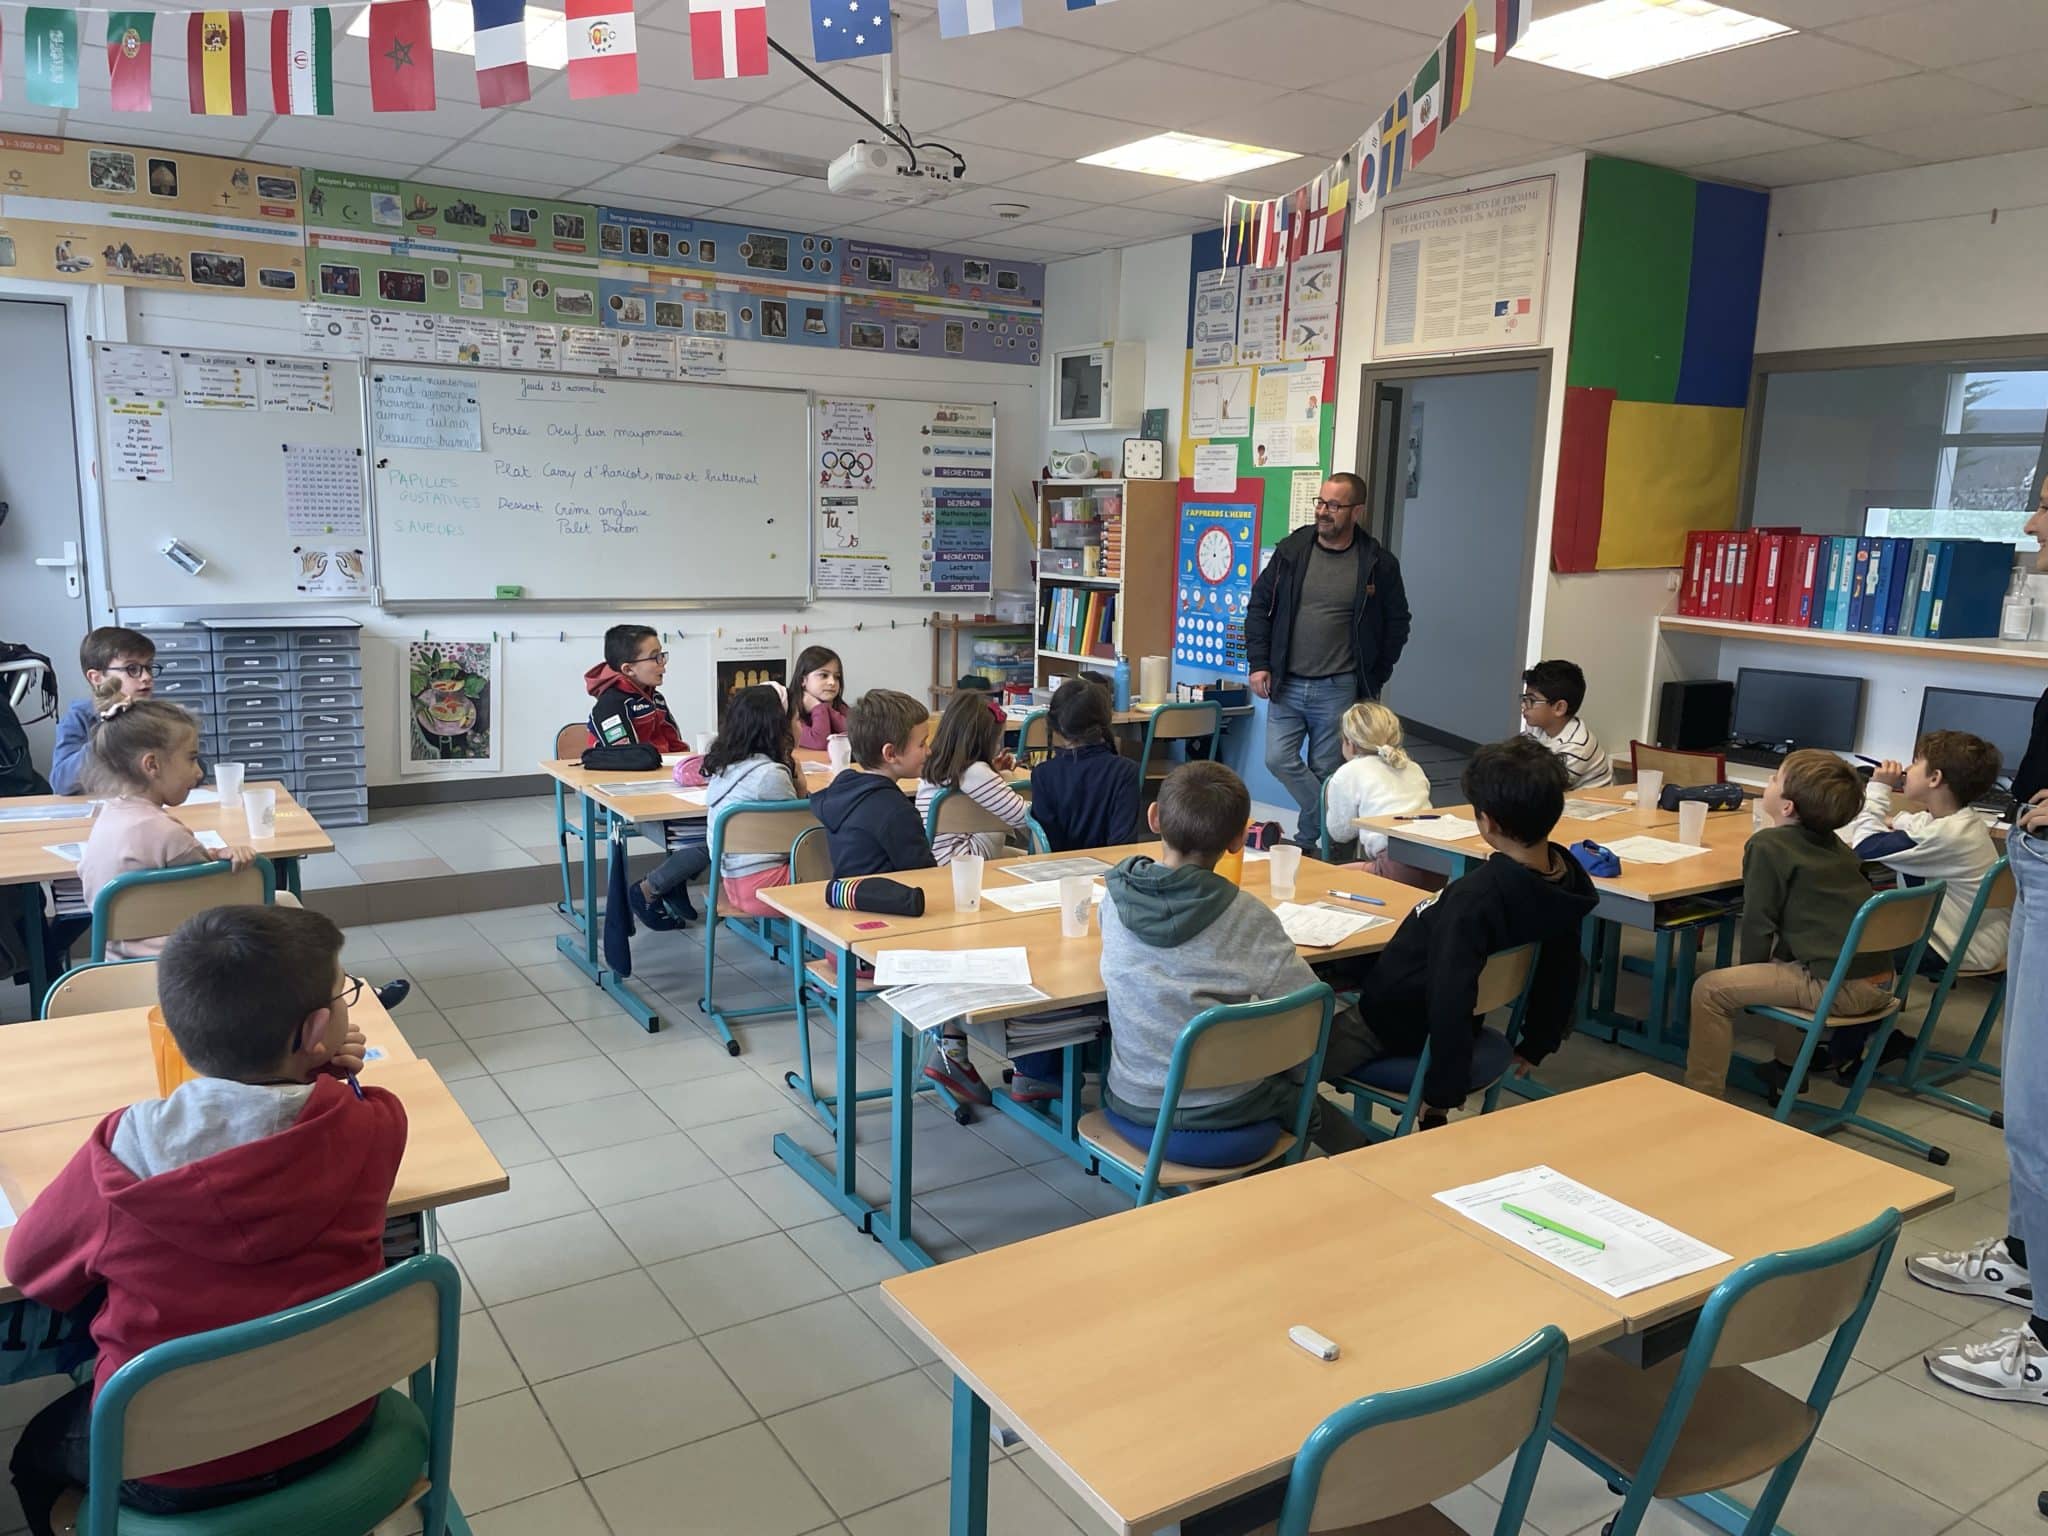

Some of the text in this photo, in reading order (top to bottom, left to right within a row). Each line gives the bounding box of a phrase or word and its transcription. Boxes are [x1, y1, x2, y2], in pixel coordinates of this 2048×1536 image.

[317, 175, 341, 187] Moyen
[609, 213, 628, 225] Temps
[202, 356, 237, 367] La phrase
[520, 377, 607, 398] Jeudi 23 novembre
[492, 422, 684, 447] Entrée Oeuf dur mayonnaise
[494, 460, 532, 479] Plat
[388, 469, 460, 490] PAPILLES
[399, 489, 481, 511] GUSTATIVES
[942, 489, 982, 498] Orthographe
[497, 496, 544, 513] Dessert
[1186, 510, 1252, 519] J'APPRENDS L'HEURE
[394, 519, 465, 537] SAVEURS
[557, 519, 593, 535] Palet
[948, 563, 974, 571] Lecture
[940, 573, 980, 582] Orthographe
[949, 584, 975, 592] SORTIE
